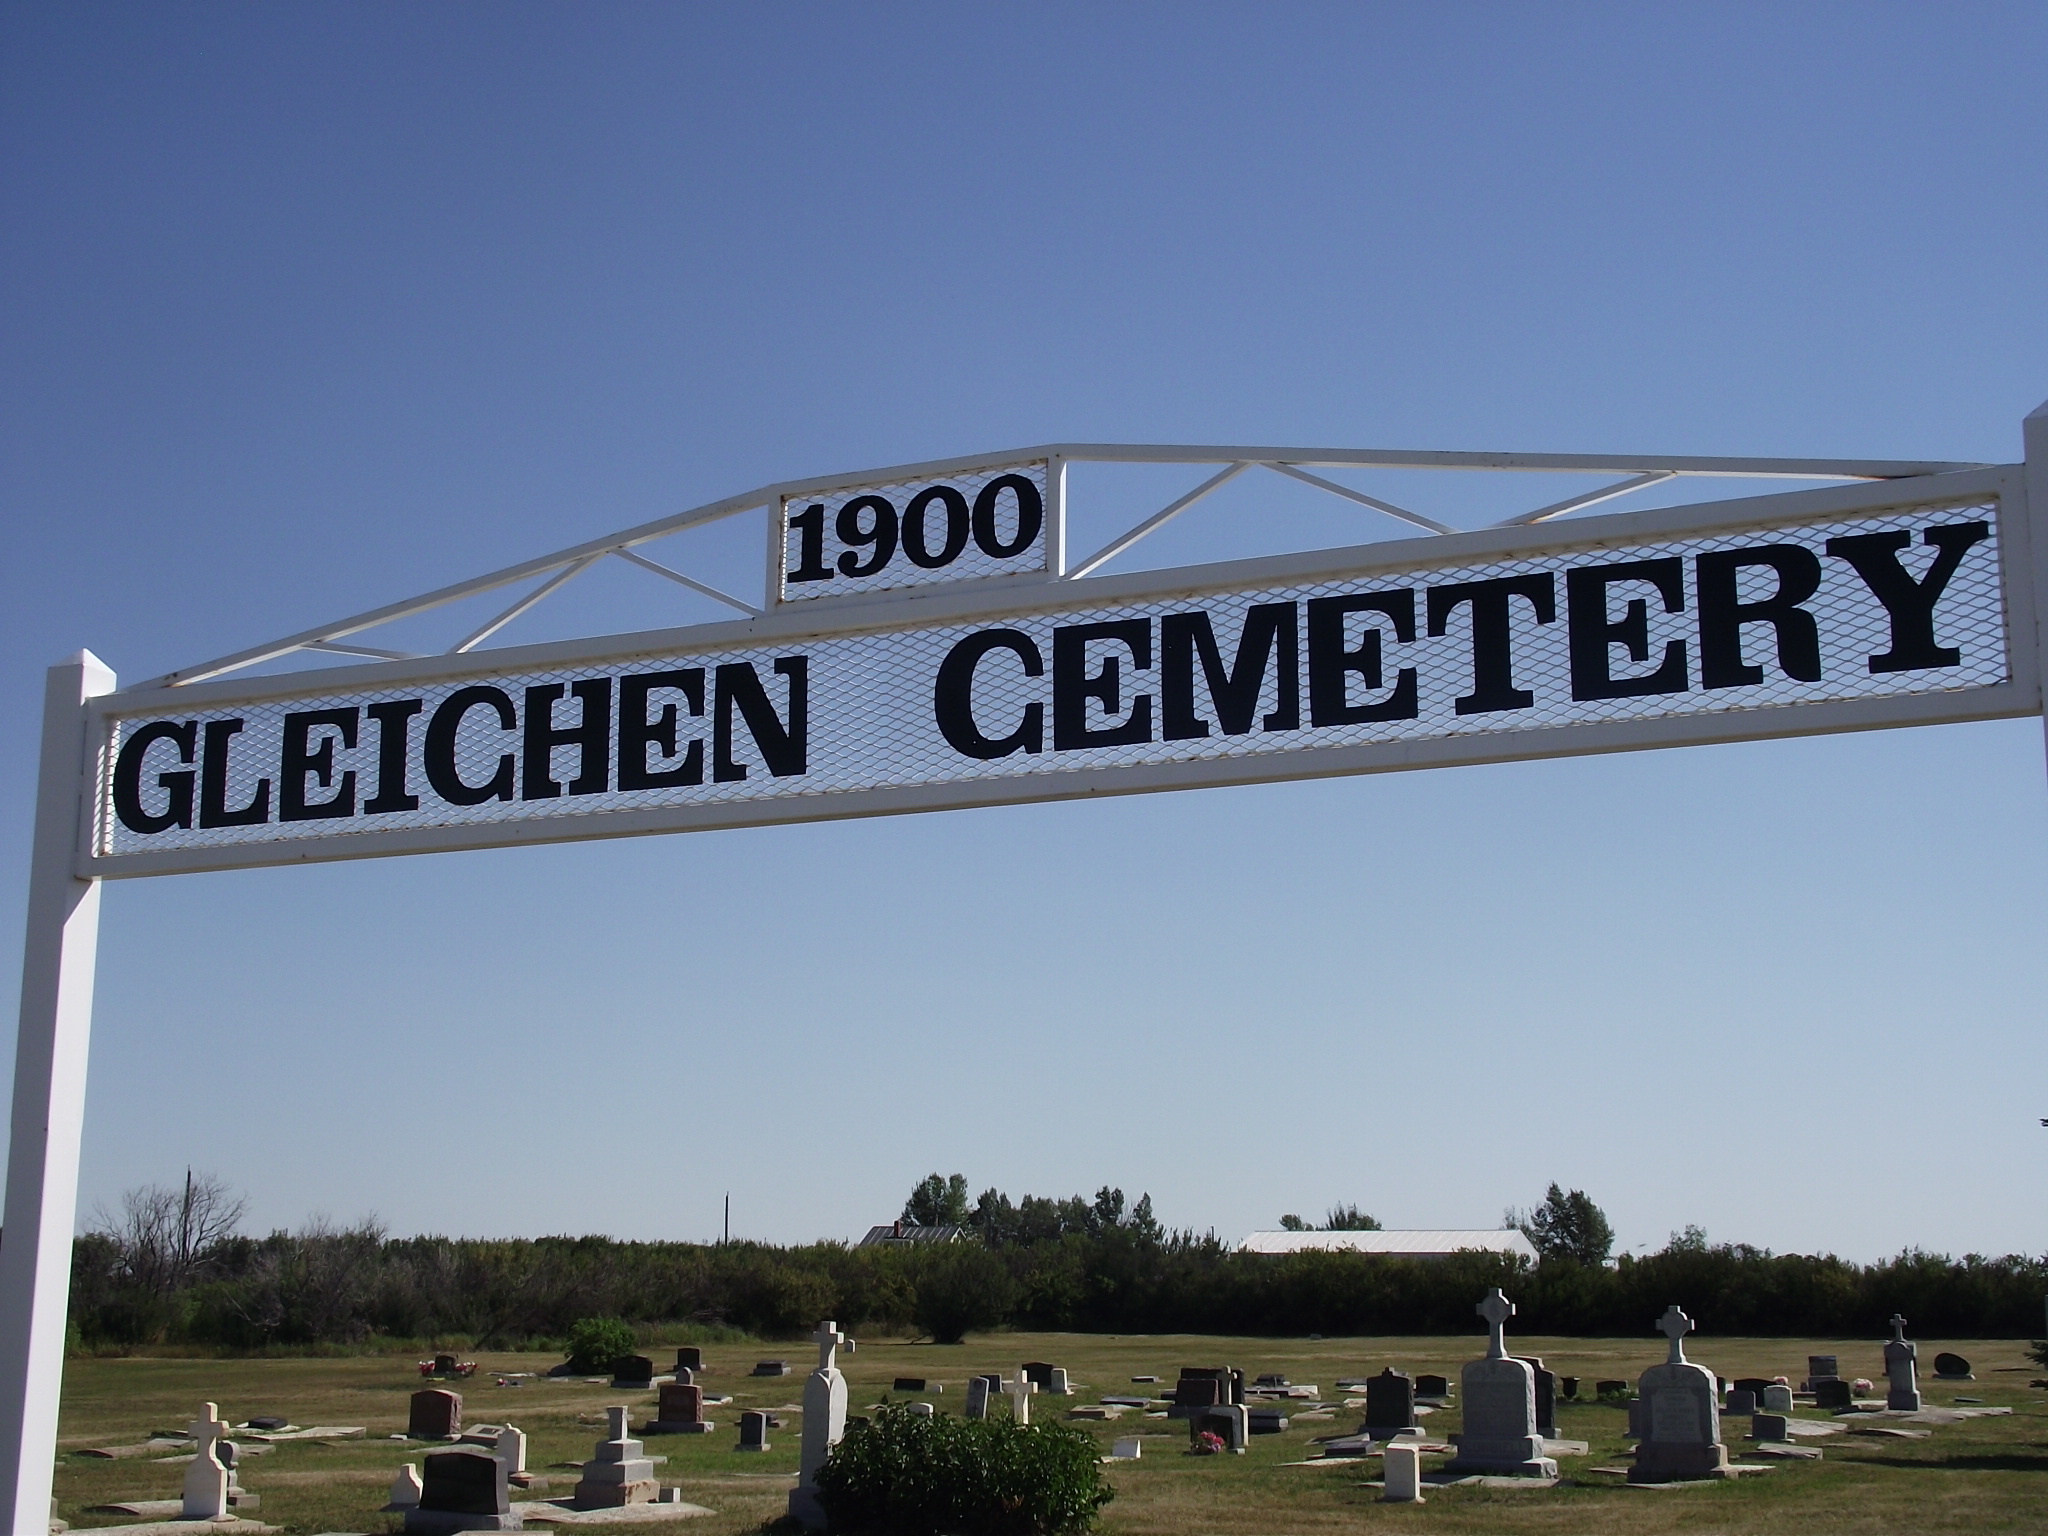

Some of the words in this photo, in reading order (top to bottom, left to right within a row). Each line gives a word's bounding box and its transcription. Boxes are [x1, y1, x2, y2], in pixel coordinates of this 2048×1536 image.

[787, 474, 1043, 583] 1900
[112, 655, 808, 835] GLEICHEN
[934, 521, 1992, 761] CEMETERY
